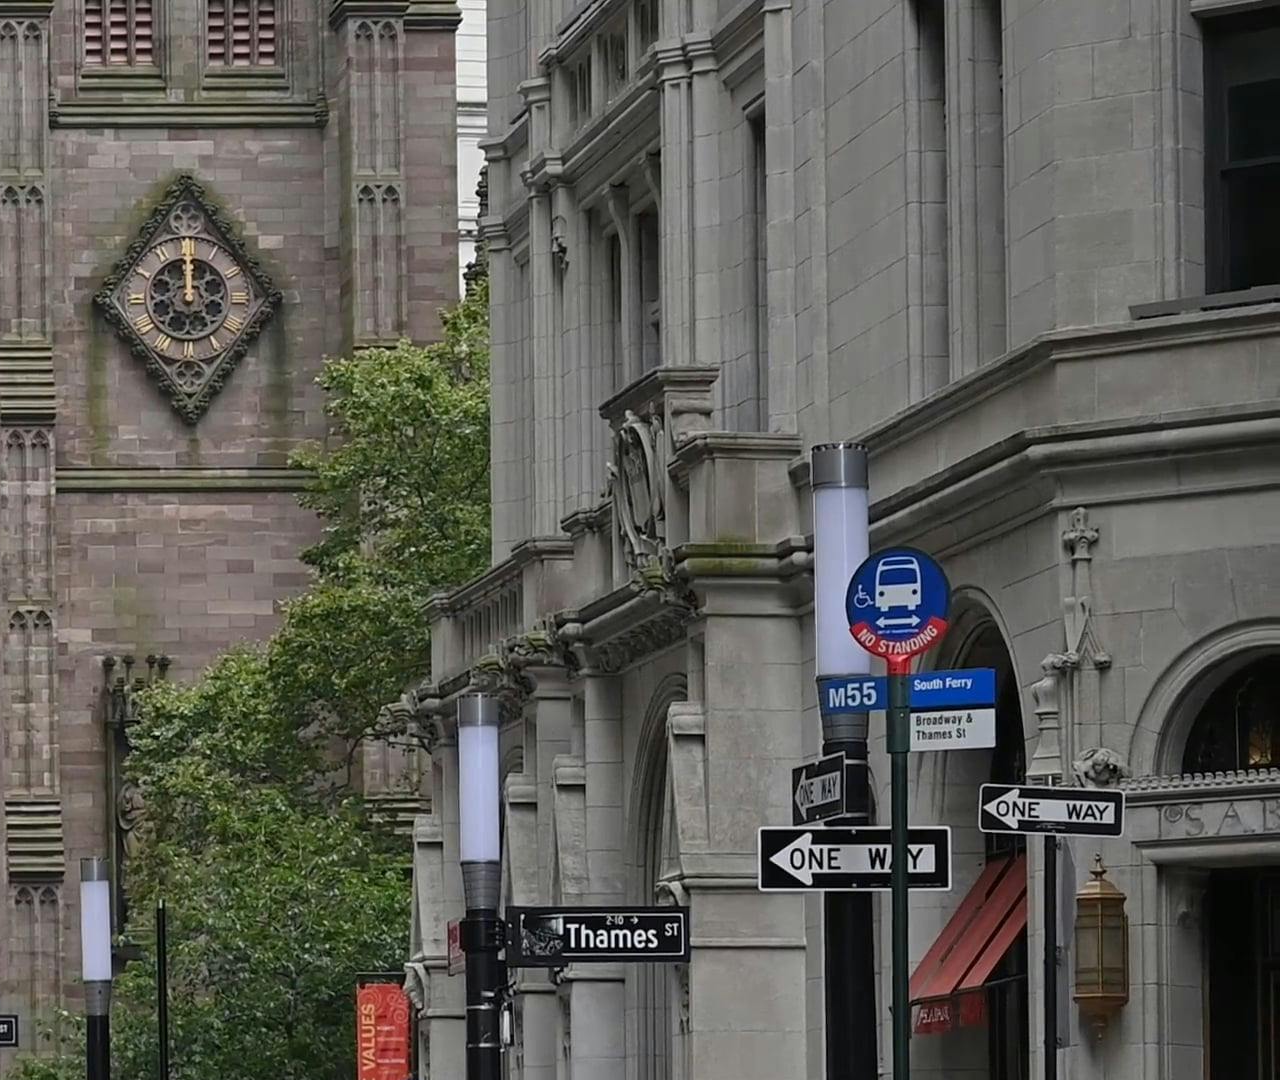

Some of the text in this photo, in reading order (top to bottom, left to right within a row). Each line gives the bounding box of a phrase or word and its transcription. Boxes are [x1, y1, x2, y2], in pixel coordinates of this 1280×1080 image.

[857, 625, 938, 654] NO STANDING
[829, 682, 877, 708] M55
[914, 678, 973, 691] South Ferry
[916, 713, 973, 727] Broadway &
[916, 729, 966, 741] Thames St
[800, 774, 838, 806] ONE WAY
[995, 800, 1110, 821] ONE WAY
[790, 848, 924, 870] ONE WY
[566, 923, 679, 949] Thames ST
[361, 1003, 376, 1070] VALUES
